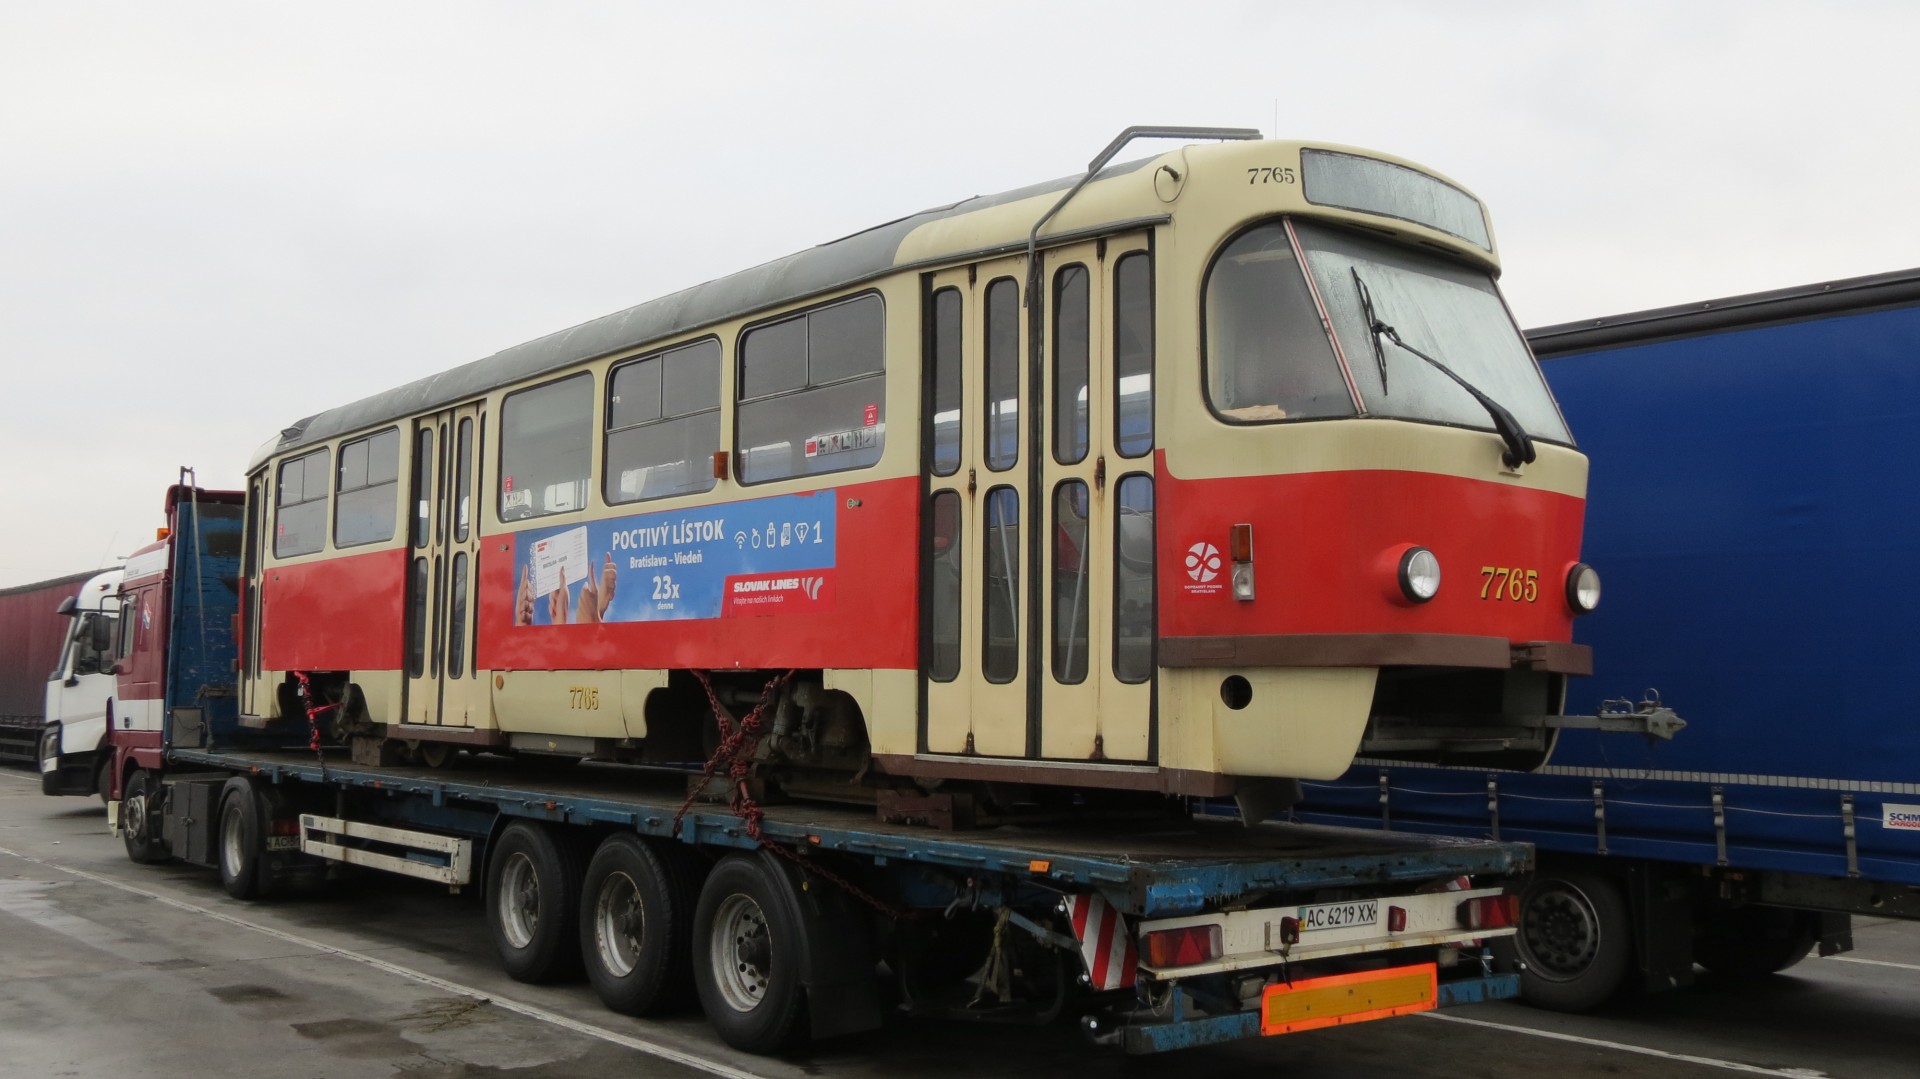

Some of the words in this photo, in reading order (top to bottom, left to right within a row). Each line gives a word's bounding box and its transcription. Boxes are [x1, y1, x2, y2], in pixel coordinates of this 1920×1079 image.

[1247, 166, 1296, 185] 7765
[612, 521, 670, 551] POCTIVÝ
[673, 518, 725, 545] LÍSTOK
[629, 554, 668, 569] Bratislava
[674, 549, 703, 565] Viedeň
[652, 575, 680, 600] 23x
[733, 580, 770, 593] SLOVAK
[771, 578, 800, 590] LINES
[1480, 566, 1539, 603] 7765
[657, 601, 674, 610] denne
[569, 687, 599, 711] 7765
[1306, 908, 1325, 928] AC
[1328, 906, 1355, 926] 6219
[1358, 903, 1374, 922] XX
